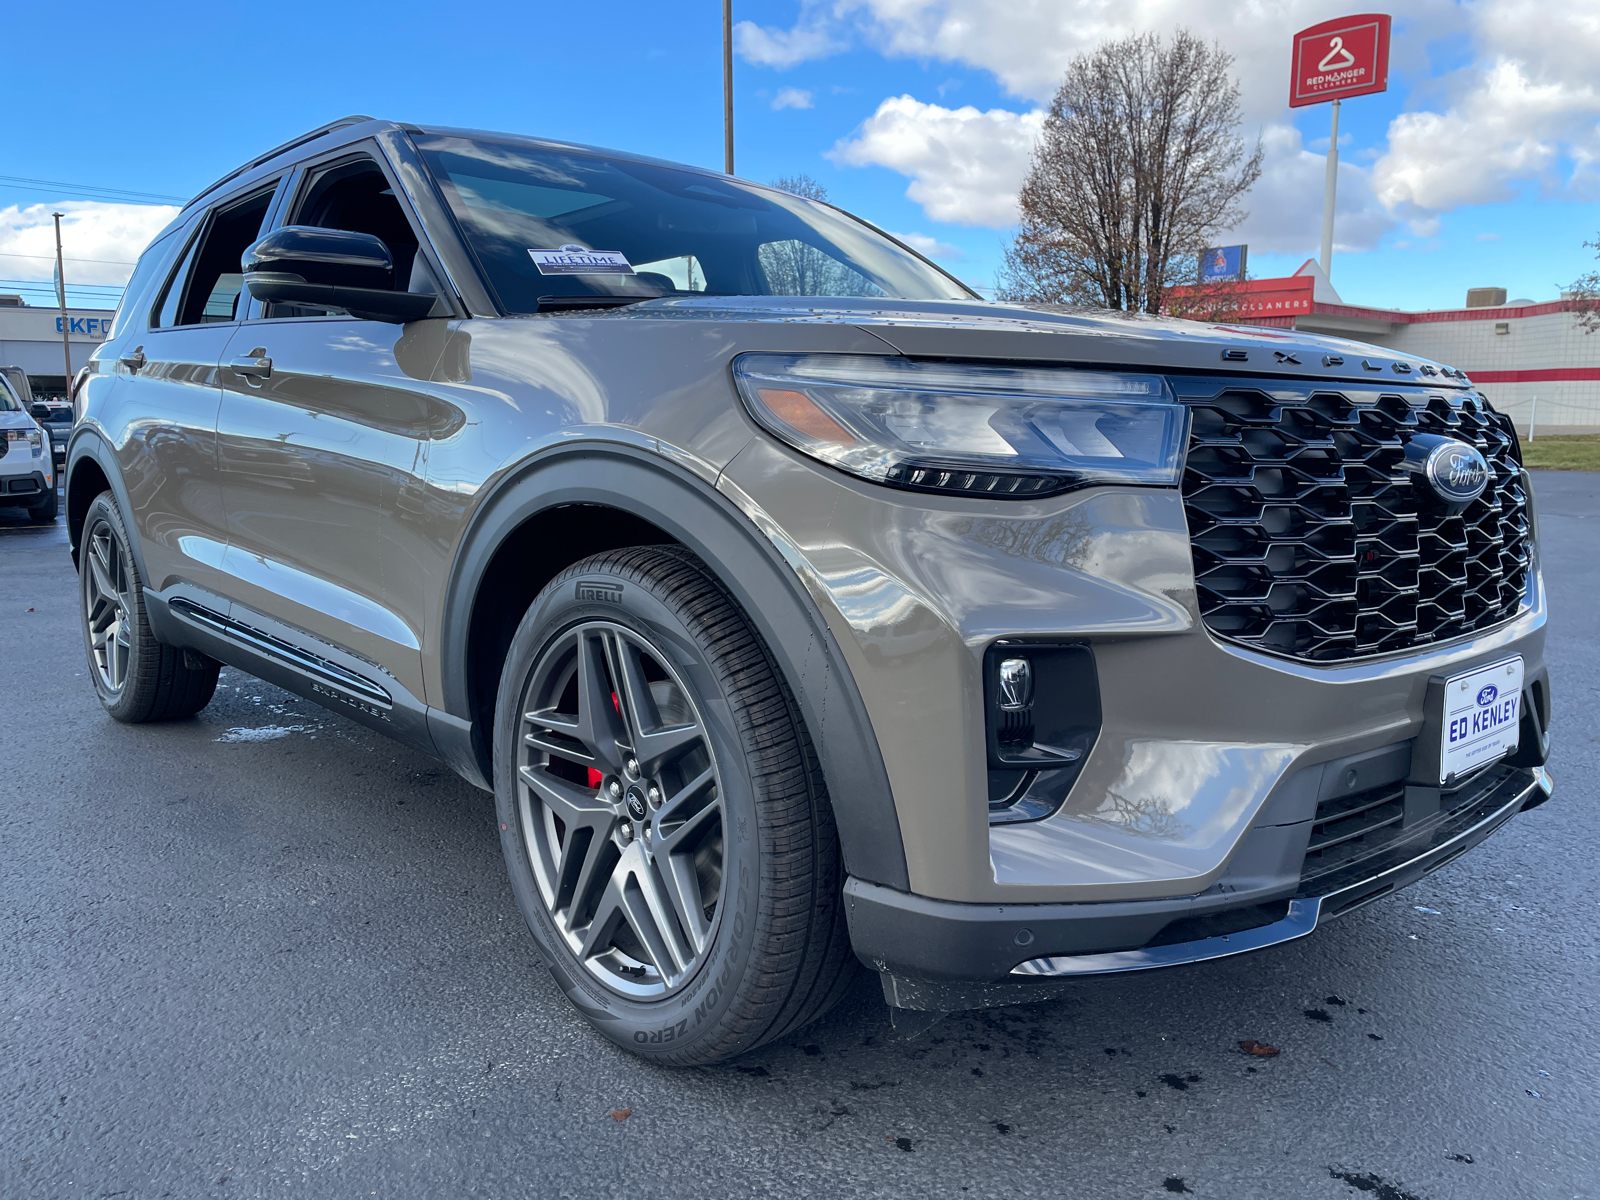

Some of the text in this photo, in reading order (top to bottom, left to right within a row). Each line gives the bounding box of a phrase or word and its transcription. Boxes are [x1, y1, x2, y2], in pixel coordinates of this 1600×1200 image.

[1306, 68, 1365, 86] RED HANGER
[1313, 77, 1357, 90] CLEANERS
[544, 256, 618, 264] LIFETIME
[1242, 300, 1308, 311] CLEANERS
[1449, 453, 1484, 486] Ford
[575, 581, 624, 604] PIRELLI
[1480, 688, 1495, 705] Ford
[1449, 697, 1518, 743] ED KENLEY
[633, 858, 754, 1044] SCORPION ZERO
